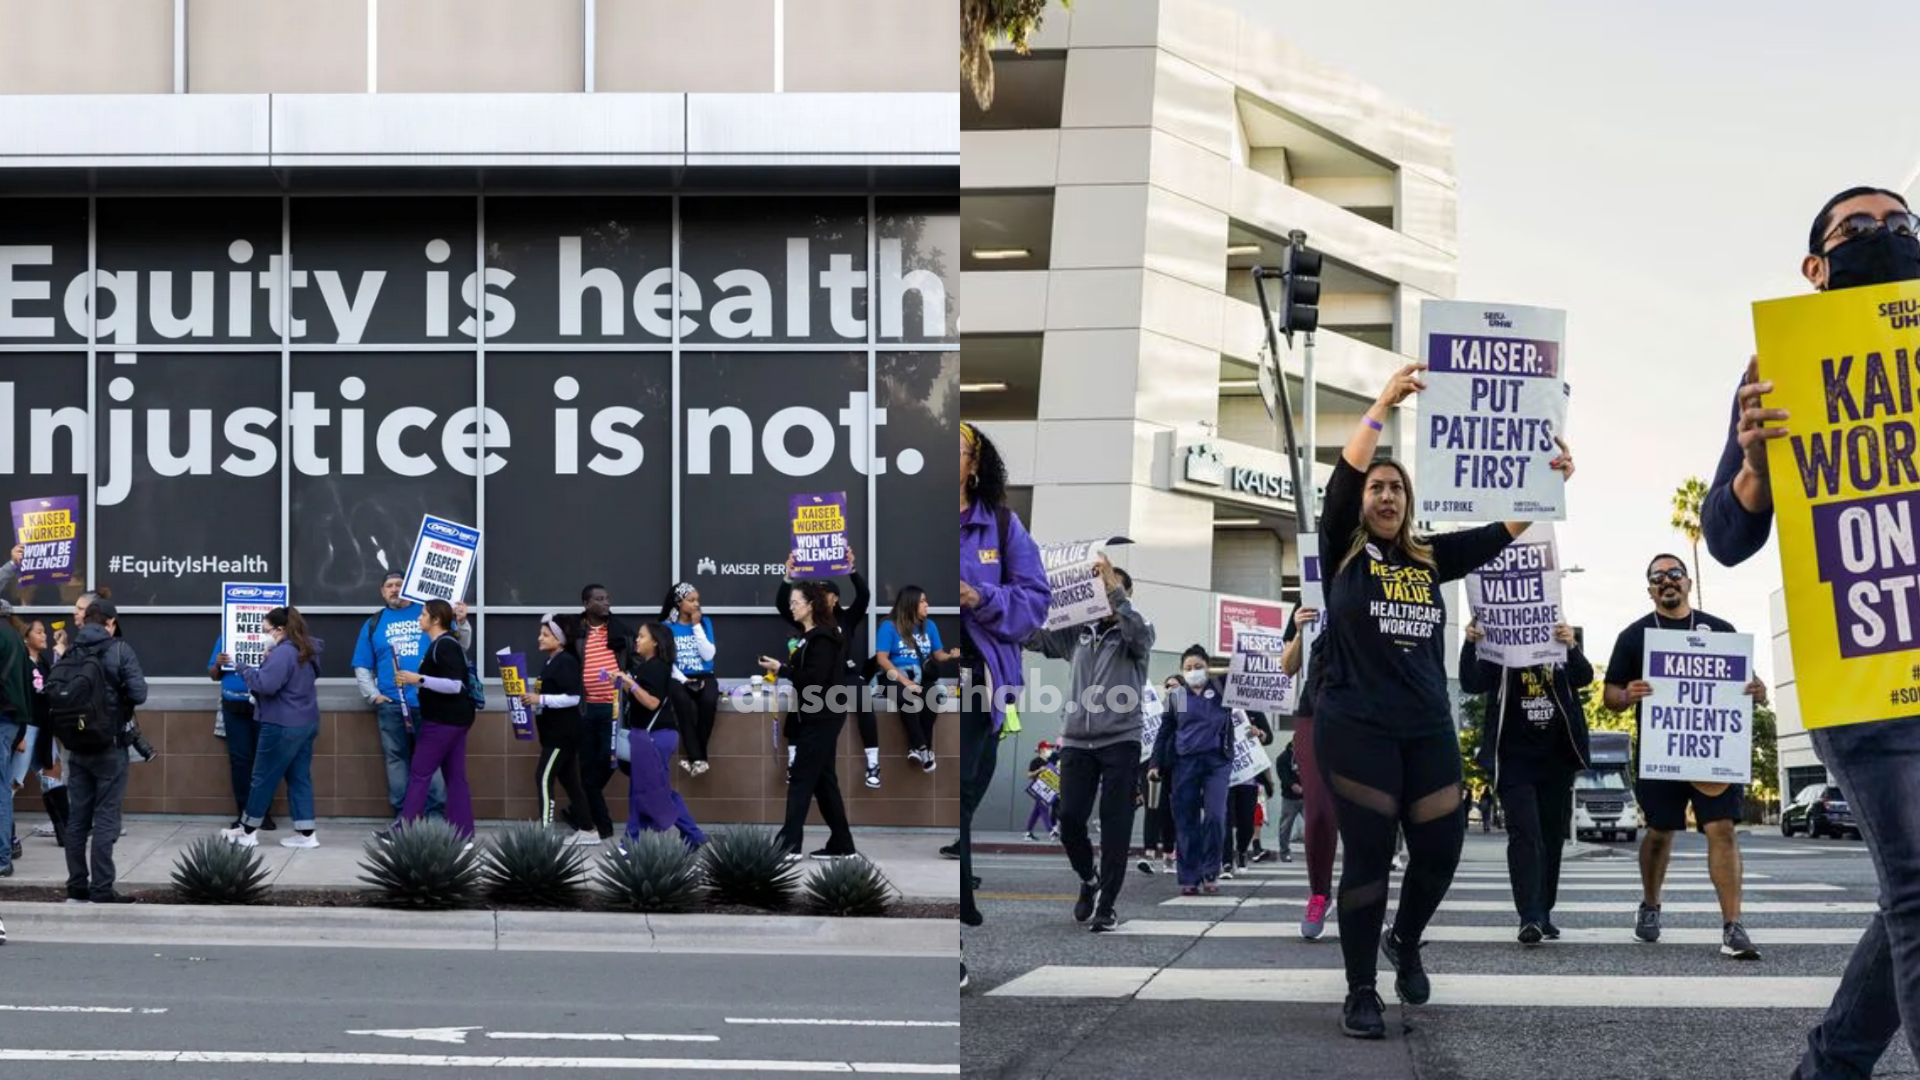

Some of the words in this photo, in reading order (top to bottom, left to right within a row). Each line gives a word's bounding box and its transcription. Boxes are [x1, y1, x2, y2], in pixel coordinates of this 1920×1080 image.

[0, 239, 387, 364] Equity
[425, 239, 516, 338] is
[559, 236, 959, 339] health
[1450, 338, 1543, 374] KAISER:
[1470, 377, 1524, 413] PUT
[0, 376, 511, 505] Injustice
[554, 376, 644, 476] is
[687, 391, 924, 477] not.
[1429, 414, 1554, 452] PATIENTS
[1454, 453, 1531, 489] FIRST
[1232, 466, 1294, 499] KAISE
[802, 507, 836, 519] KAISER
[1422, 500, 1440, 512] ULP
[1442, 500, 1473, 513] STRIKE
[28, 512, 66, 526] KAISER
[796, 519, 842, 532] WORKERS
[23, 525, 72, 540] WORKERS
[796, 535, 829, 549] WON'T
[831, 533, 844, 547] BE
[1838, 500, 1916, 574] ON
[23, 542, 58, 558] WON'T
[57, 541, 72, 555] BE
[796, 547, 844, 562] SILENCED
[20, 555, 70, 572] SILENCED
[109, 555, 268, 578] #EquityIsHealth
[425, 551, 462, 573] RESPECT
[721, 563, 760, 575] KAISER
[764, 563, 786, 575] PER
[420, 566, 457, 587] HEALTHCARE
[417, 579, 454, 601] WORKERS
[1382, 581, 1434, 604] VALUE
[1483, 577, 1541, 603] VALUE
[236, 612, 267, 623] PATIEN
[1370, 601, 1442, 624] HEALTHCARE
[1473, 605, 1558, 627] HEALTHCARE
[1848, 573, 1920, 648] ST
[1379, 618, 1434, 638] WORKERS
[1484, 625, 1550, 646] WORKERS
[235, 642, 265, 653] CORPORA
[1240, 634, 1283, 653] RESPEC
[235, 653, 264, 665] GREE
[1664, 654, 1732, 678] KAISER:
[1230, 673, 1292, 689] HEALTHCARE
[1236, 686, 1285, 701] WORKERS
[1678, 681, 1716, 705] PUT
[1651, 705, 1742, 734] PATIENTS
[1667, 733, 1724, 758] FIRST
